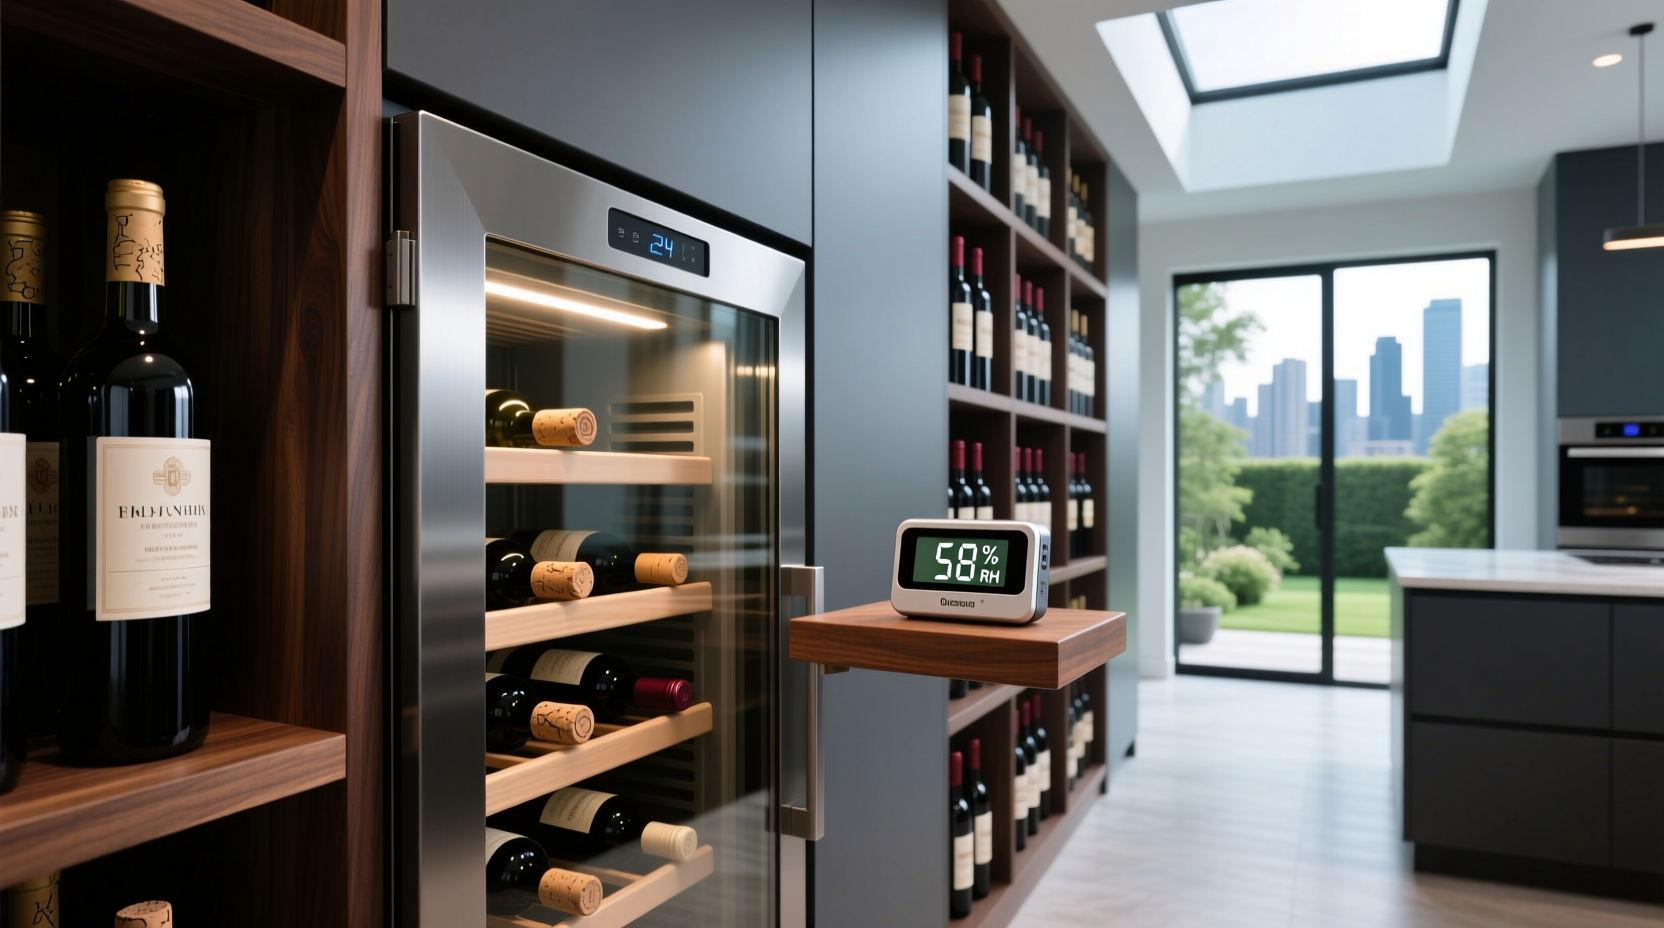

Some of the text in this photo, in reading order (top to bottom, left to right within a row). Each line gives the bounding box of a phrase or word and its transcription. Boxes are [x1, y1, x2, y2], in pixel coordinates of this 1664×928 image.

[649, 233, 674, 258] 24
[934, 543, 999, 582] 58 %
[979, 569, 1000, 584] RH
